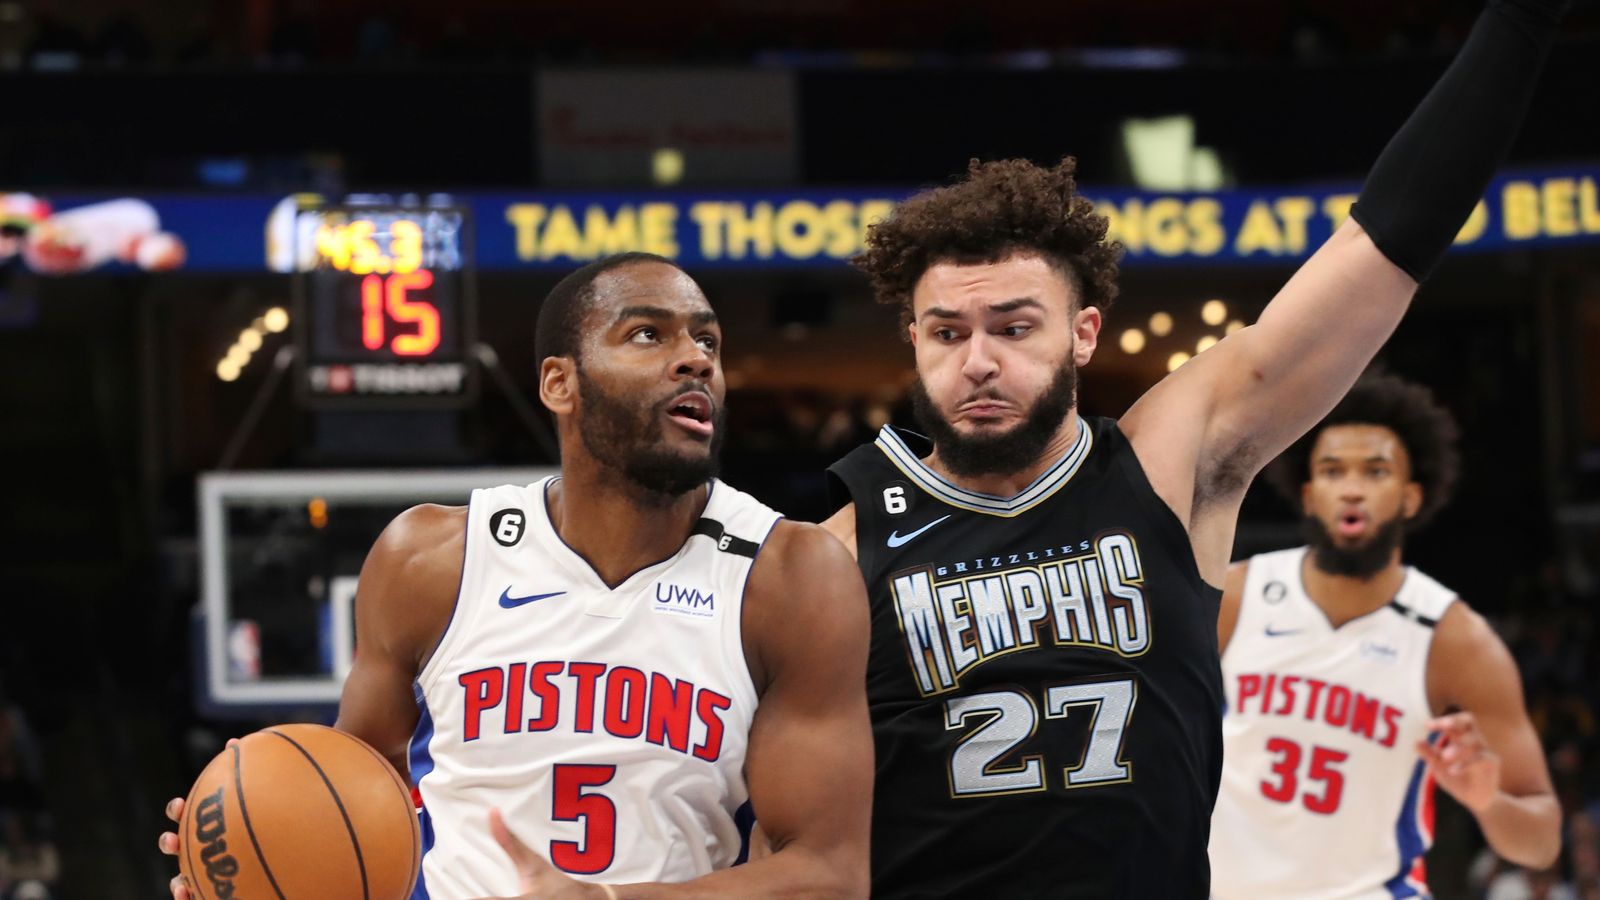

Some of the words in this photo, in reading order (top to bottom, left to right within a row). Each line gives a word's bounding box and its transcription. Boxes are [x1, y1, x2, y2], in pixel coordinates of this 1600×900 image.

[508, 203, 680, 260] TAME
[1235, 199, 1317, 255] AT
[361, 268, 441, 356] 15
[496, 513, 522, 543] 6
[882, 486, 907, 514] 6
[717, 535, 732, 551] 6
[937, 540, 1090, 576] GRIZZLIES
[656, 582, 714, 610] UWM
[890, 533, 1152, 698] MEMPHIS
[458, 660, 732, 763] PISTONS
[944, 680, 1138, 799] 27
[1236, 673, 1404, 748] PISTONS
[1259, 736, 1350, 815] 35
[550, 763, 617, 875] 5
